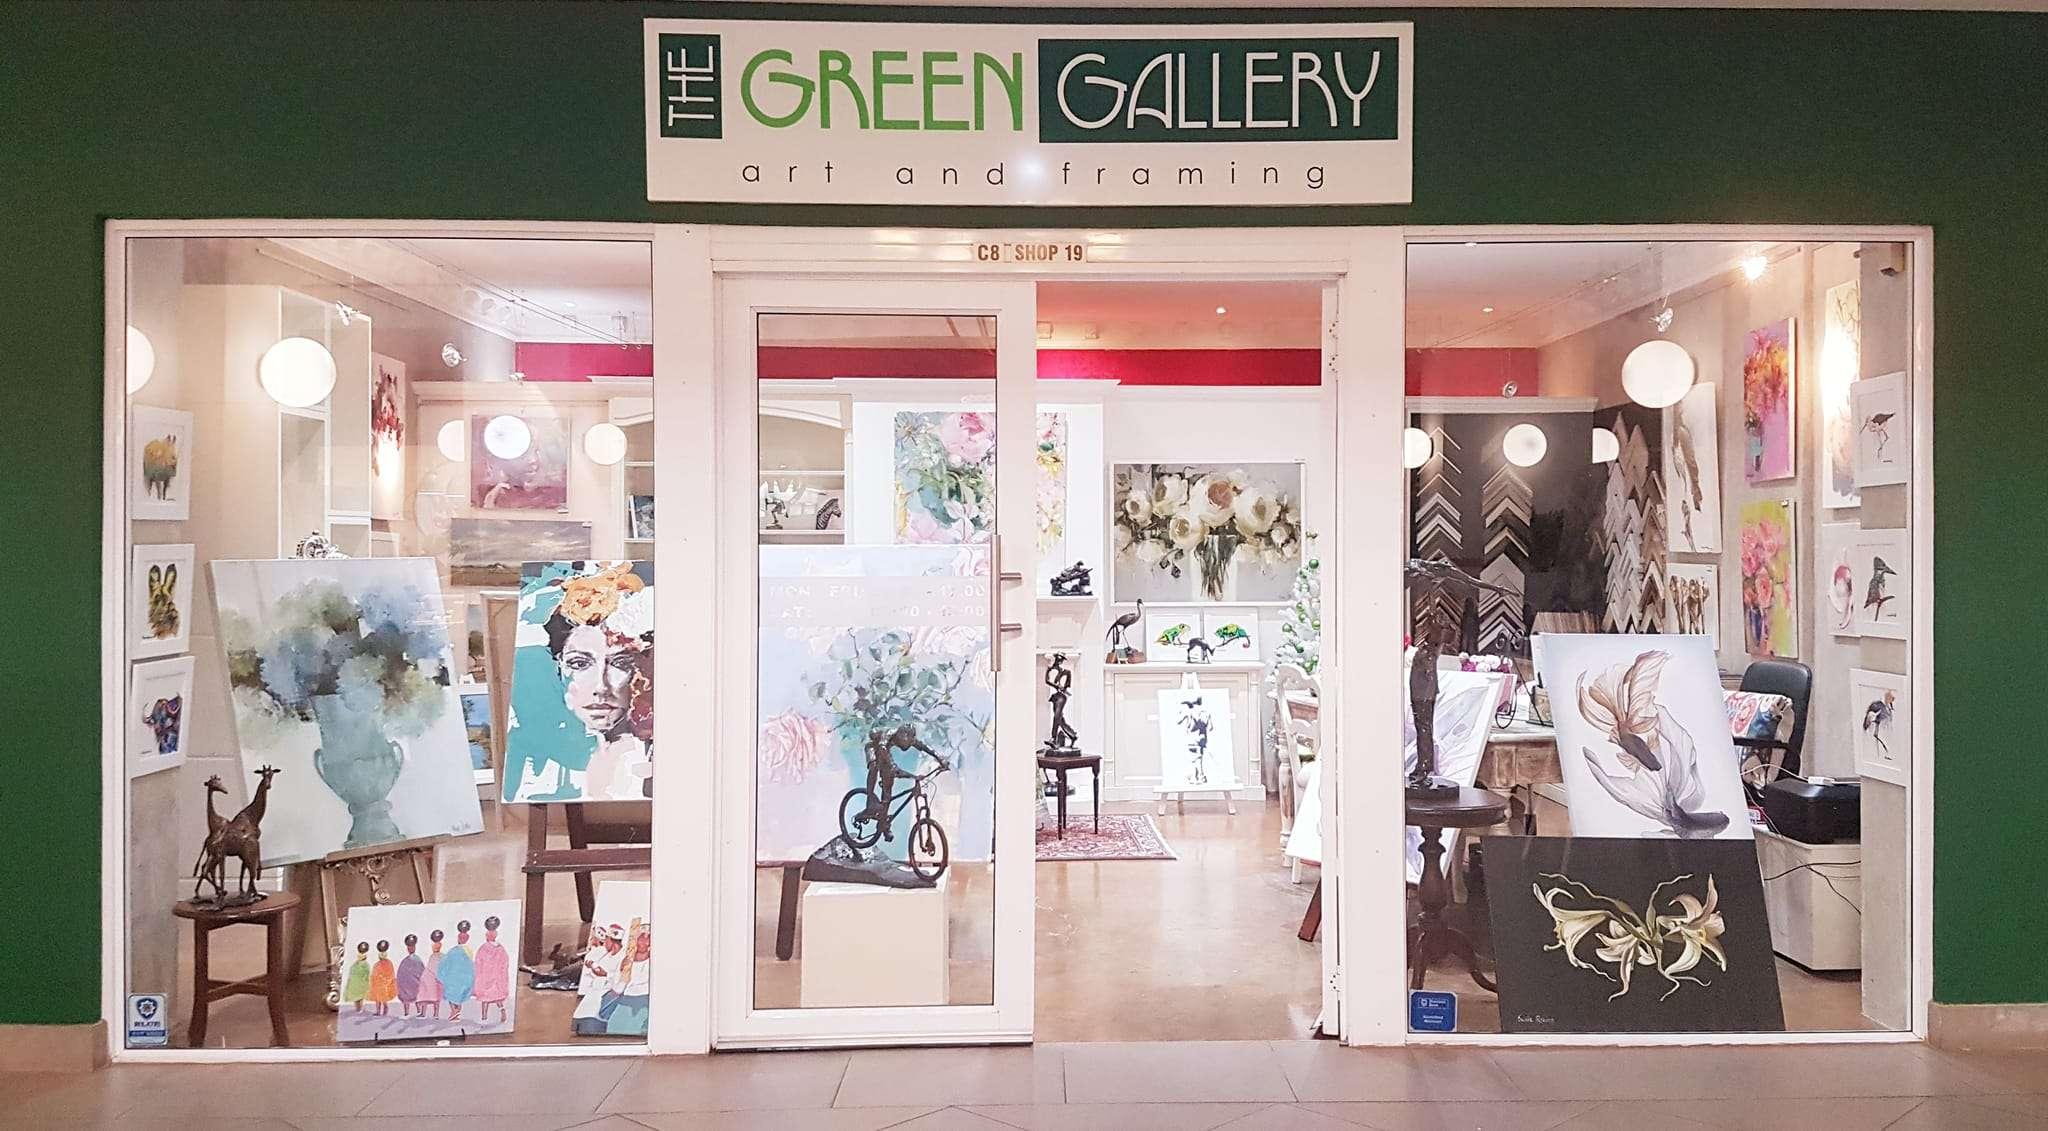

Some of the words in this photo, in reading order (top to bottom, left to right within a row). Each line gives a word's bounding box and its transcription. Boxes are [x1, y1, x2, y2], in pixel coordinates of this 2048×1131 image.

[667, 45, 714, 126] THE
[740, 49, 1022, 131] GREEN
[1057, 51, 1381, 129] GALLERY
[741, 160, 834, 184] art
[896, 160, 1004, 186] and
[1062, 161, 1325, 189] framing
[977, 244, 1000, 261] C8
[1014, 244, 1059, 261] SHOP
[1064, 244, 1083, 261] 19
